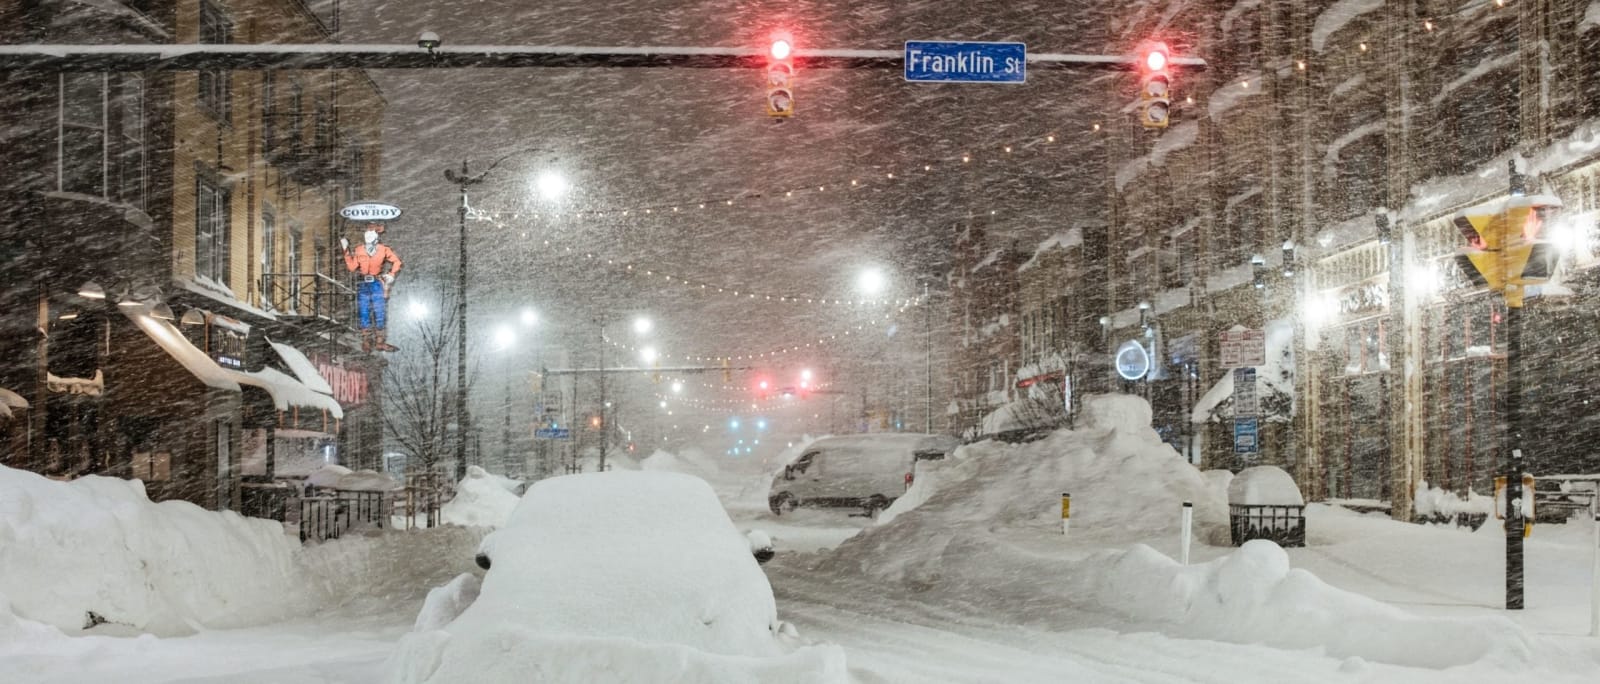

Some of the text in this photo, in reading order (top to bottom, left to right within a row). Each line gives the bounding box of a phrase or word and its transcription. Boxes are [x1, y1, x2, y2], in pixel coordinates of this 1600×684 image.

[909, 50, 1020, 74] Franklin St
[343, 208, 398, 217] COWBOY
